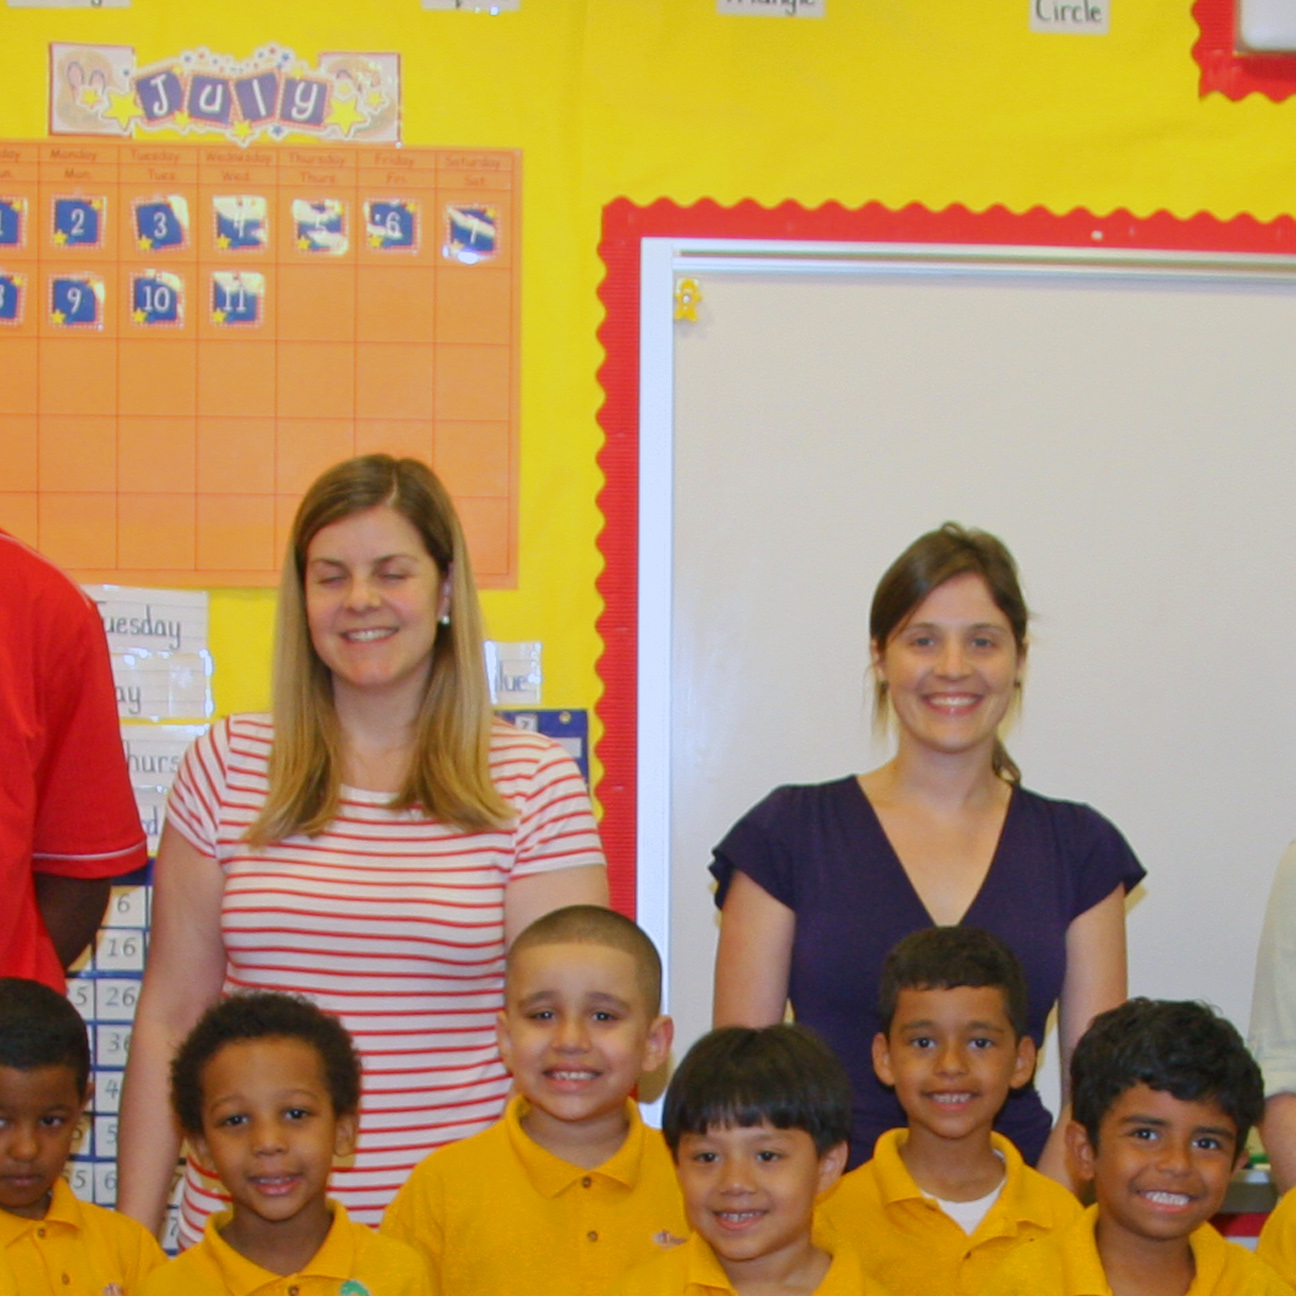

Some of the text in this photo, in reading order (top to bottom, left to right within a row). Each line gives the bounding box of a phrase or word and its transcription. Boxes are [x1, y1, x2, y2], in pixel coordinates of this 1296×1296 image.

[1035, 0, 1103, 24] Circle
[150, 73, 319, 122] July
[50, 149, 97, 162] Monday
[132, 150, 180, 164] Tuesday
[289, 153, 346, 167] Thursday
[374, 153, 414, 169] Friday
[445, 156, 501, 171] Saturday
[70, 208, 85, 236] 2
[153, 211, 168, 238] 3
[385, 211, 402, 238] 6
[66, 286, 82, 314] 9
[142, 285, 170, 312] 10
[222, 286, 248, 312] 11
[116, 892, 131, 914] 6
[107, 936, 137, 958] 16
[105, 985, 136, 1007] 26
